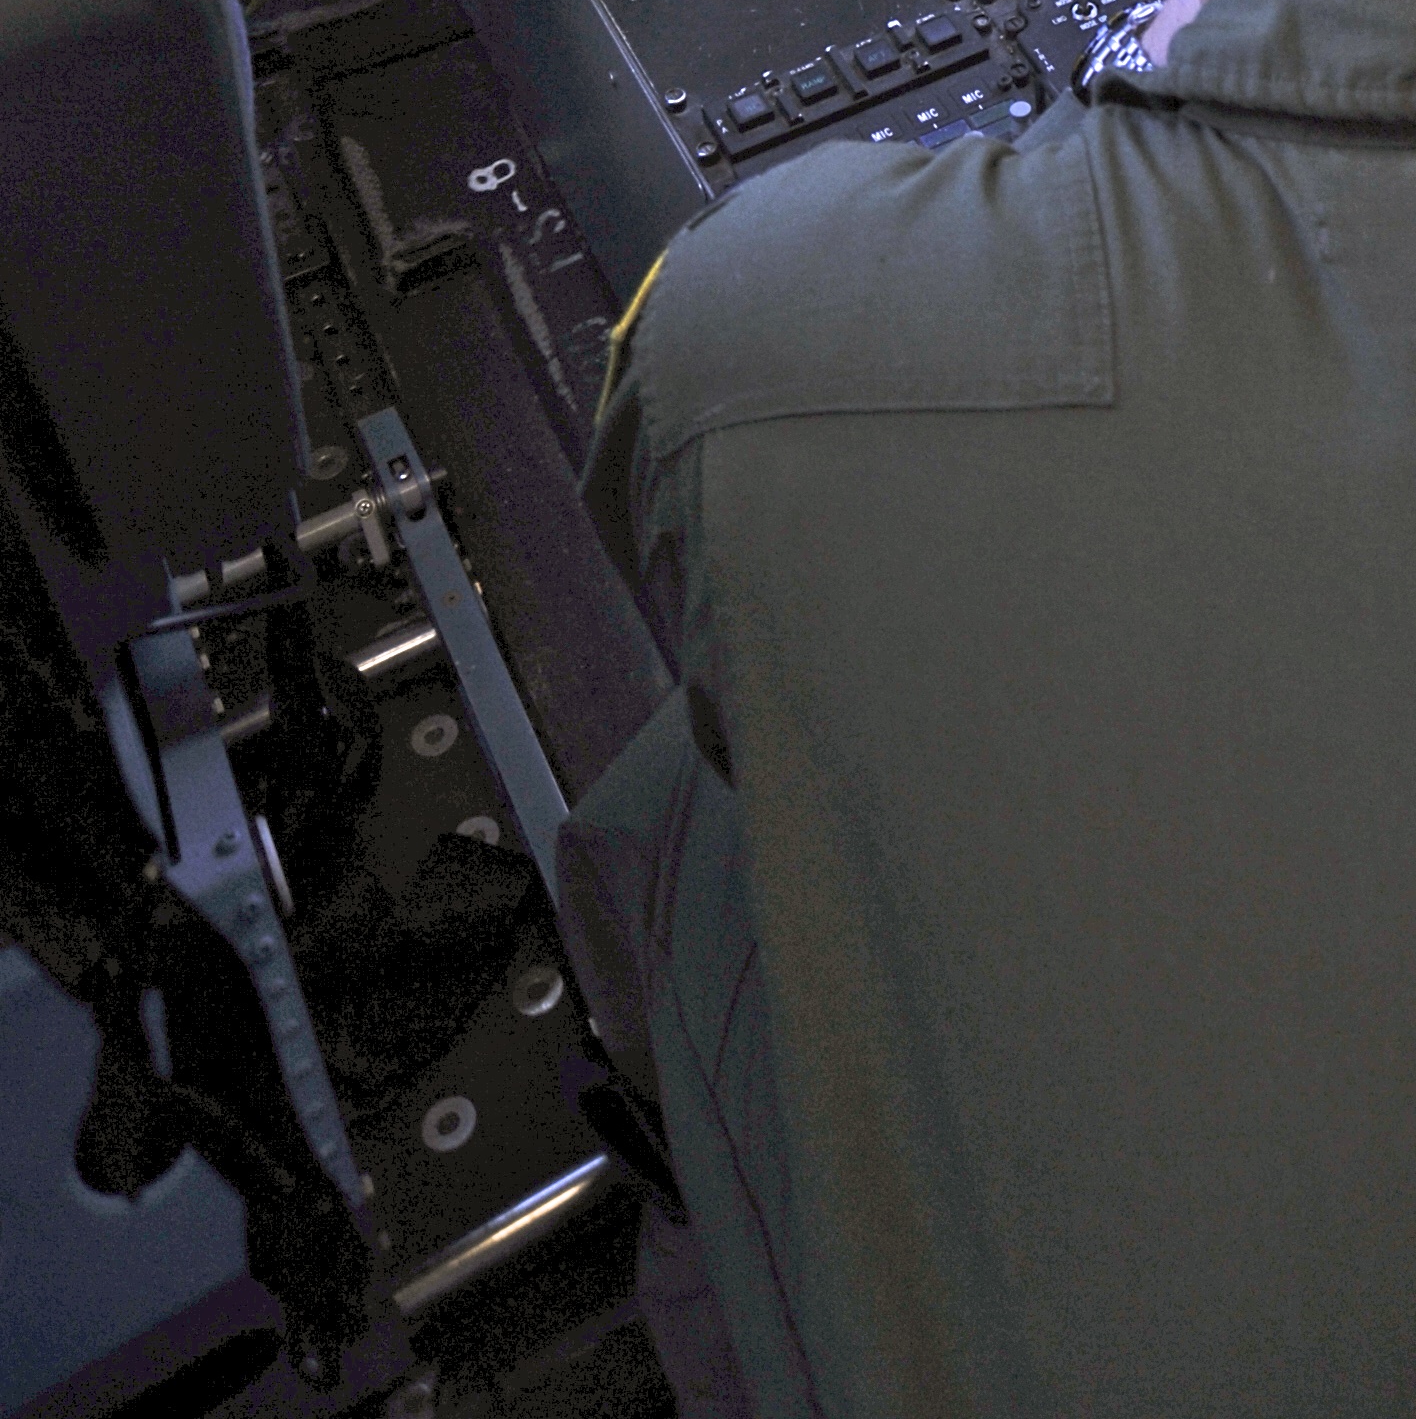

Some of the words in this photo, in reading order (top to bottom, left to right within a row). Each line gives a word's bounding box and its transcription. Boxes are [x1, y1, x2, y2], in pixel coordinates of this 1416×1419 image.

[961, 89, 984, 105] MIC
[916, 107, 940, 124] MIC
[871, 126, 894, 143] MIC
